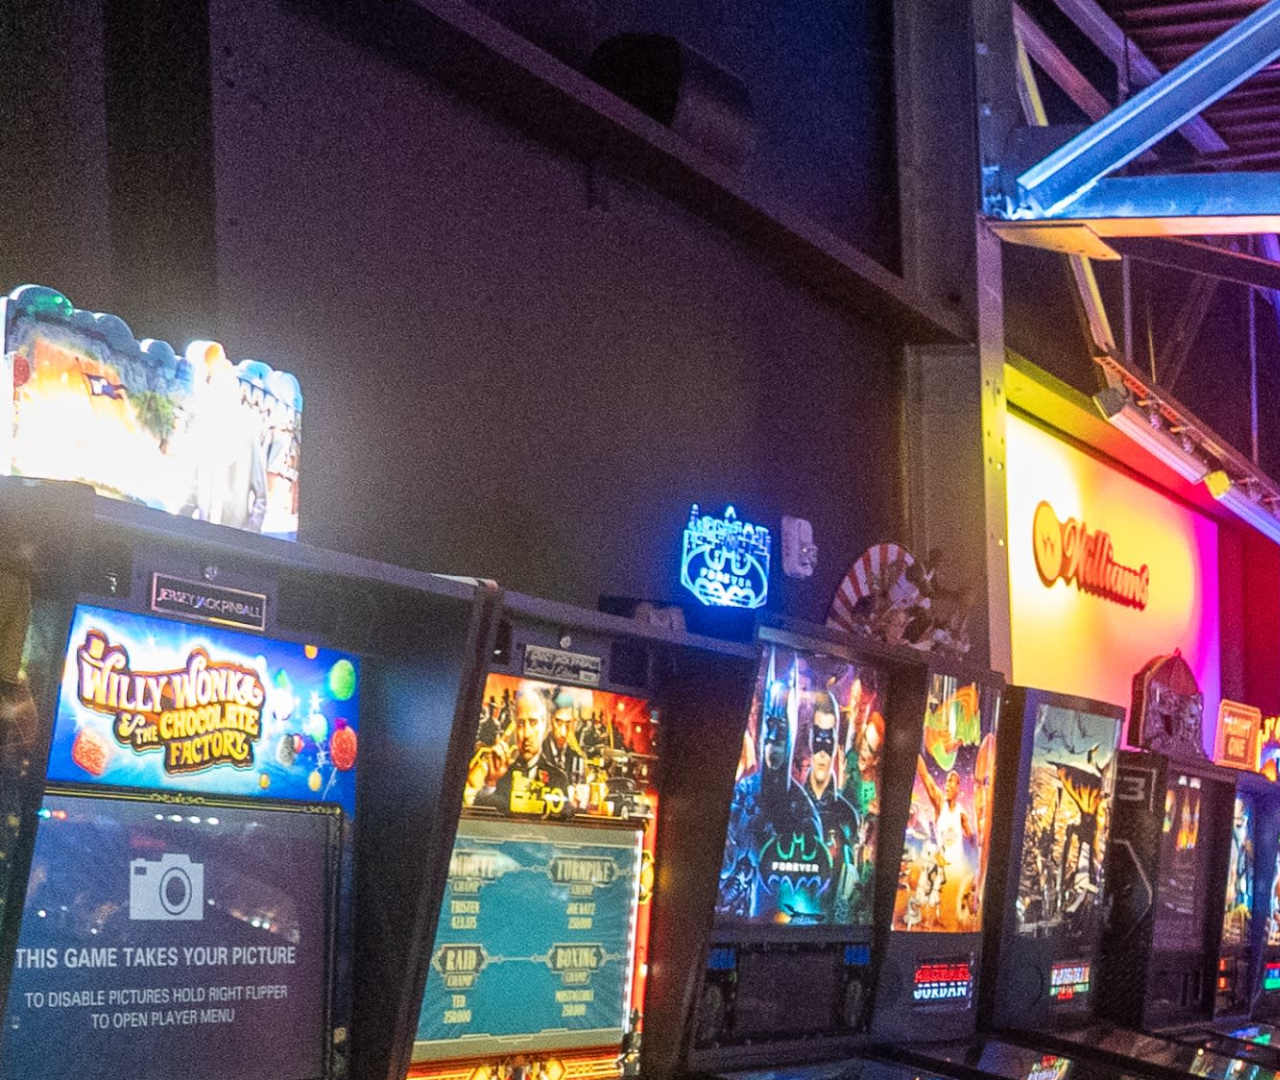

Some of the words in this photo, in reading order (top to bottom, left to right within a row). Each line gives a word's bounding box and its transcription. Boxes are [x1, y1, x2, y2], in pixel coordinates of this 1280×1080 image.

[1064, 517, 1149, 611] Williams
[157, 586, 195, 606] JERSEY
[193, 594, 222, 610] JACK
[221, 598, 261, 617] PINBALL
[80, 652, 165, 712] WILLY
[173, 656, 263, 709] WONKA
[134, 723, 158, 744] THE
[160, 704, 259, 738] CHOCOLATE
[169, 731, 249, 767] FACTORY
[772, 861, 819, 873] FOREVER
[16, 948, 58, 969] THIS
[64, 948, 118, 968] GAME
[124, 947, 178, 967] TAKES
[184, 946, 228, 967] YOUR
[232, 946, 296, 966] PICTURE
[25, 992, 46, 1009] TO
[48, 989, 105, 1009] DISABLE
[109, 987, 171, 1006] PICTURES
[173, 986, 206, 1003] HOLD
[209, 985, 243, 1003] RIGHT
[246, 985, 288, 1001] FLIPPER
[92, 1013, 109, 1029] TO
[113, 1011, 148, 1028] OPEN
[151, 1010, 198, 1028] PLAYER
[201, 1008, 235, 1025] MENU
